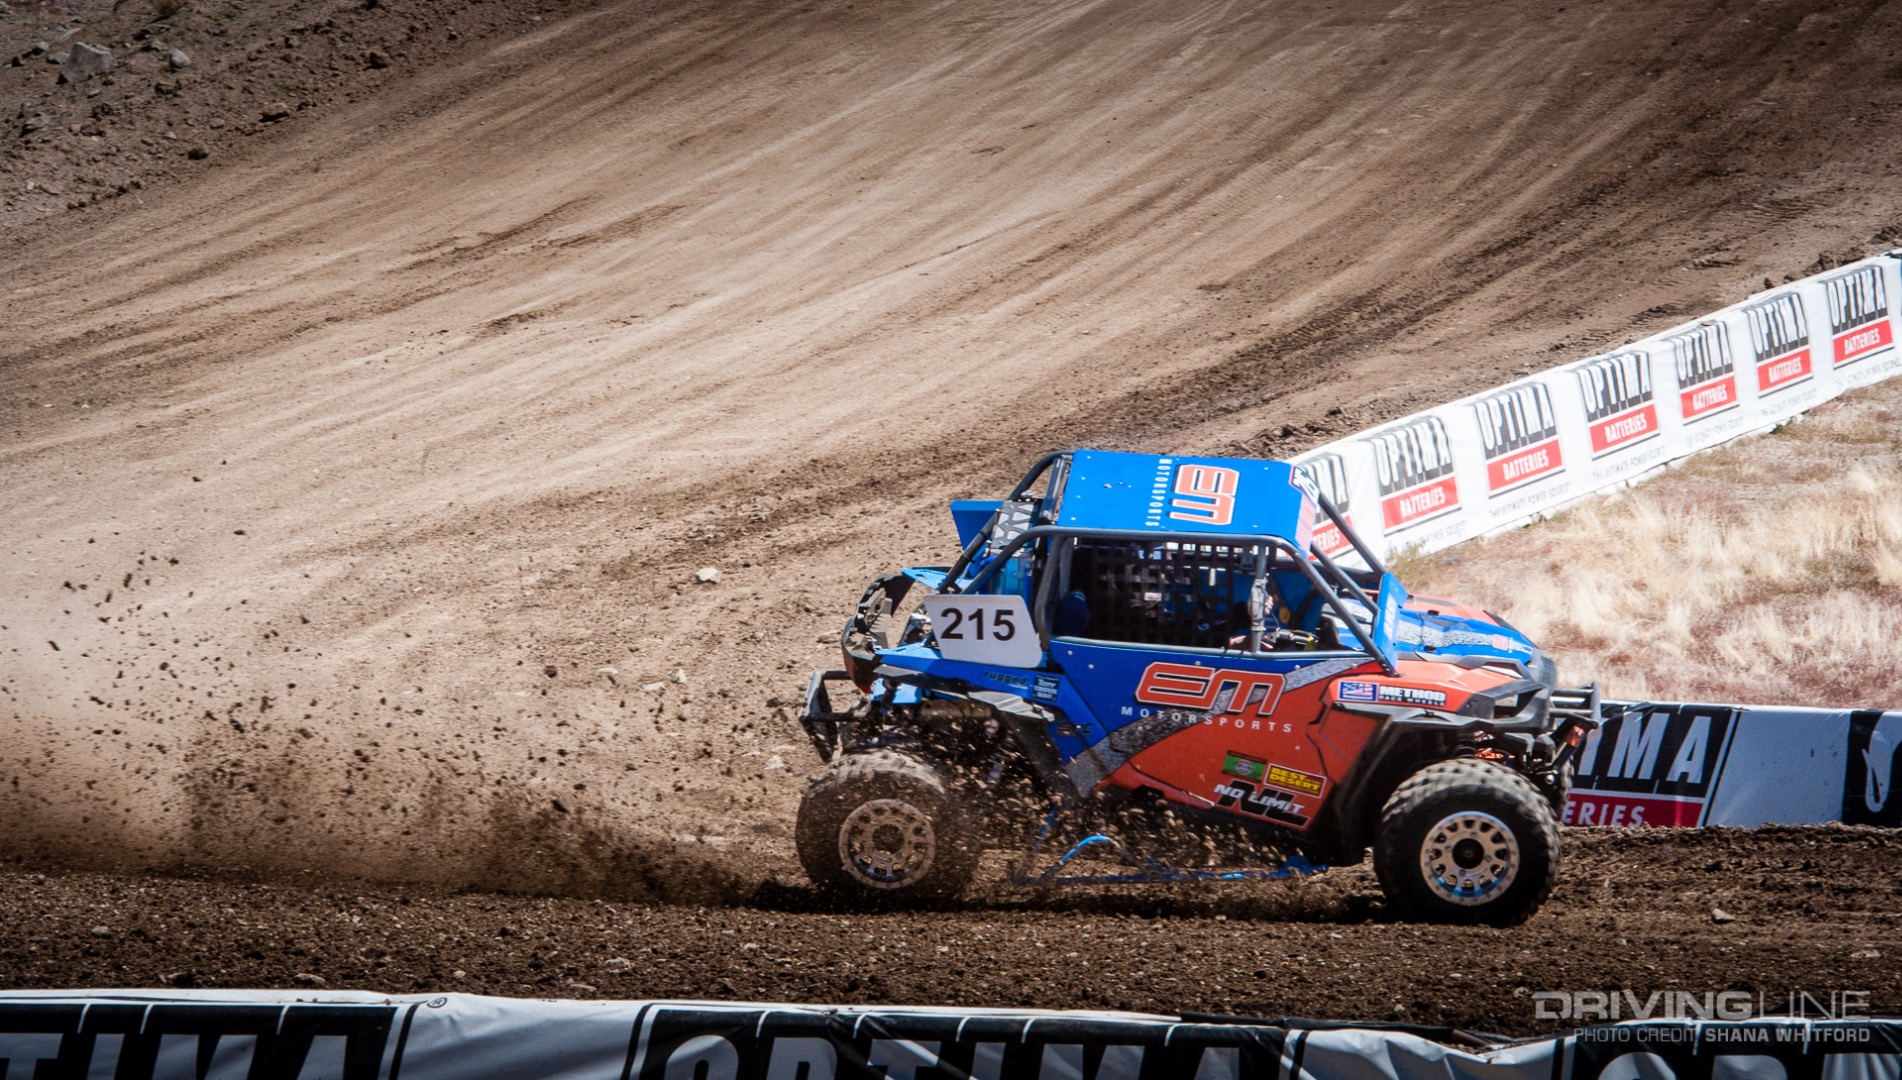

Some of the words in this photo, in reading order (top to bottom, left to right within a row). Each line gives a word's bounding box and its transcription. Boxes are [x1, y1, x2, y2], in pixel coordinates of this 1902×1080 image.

[1826, 266, 1887, 327] OPTIMA
[1748, 293, 1807, 354] OPTIMA
[1675, 322, 1731, 381] OPTIMA
[1844, 327, 1881, 355] BATTERIES
[1576, 352, 1650, 414] OPTIMA
[1768, 357, 1801, 383] BATTERIES
[1692, 384, 1728, 411] BATTERIES
[1474, 383, 1554, 450] OPTIMA
[1604, 413, 1648, 444] BATTERIES
[1373, 417, 1451, 486] OPTIMA
[1502, 449, 1549, 481] BATTERIES
[1144, 459, 1172, 526] MOTORSPORTS
[1399, 486, 1446, 518] BATTERIES
[941, 608, 1015, 641] 215
[1135, 661, 1286, 717] EM
[1378, 694, 1403, 702] RACE
[1407, 698, 1446, 707] WHEELS
[1379, 685, 1447, 702] METHOD
[1121, 706, 1292, 733] MOTORSPORTS
[1578, 711, 1711, 784] IMA
[1269, 773, 1320, 790] DESERT
[1271, 767, 1307, 781] BEST
[1213, 784, 1246, 799] NO
[1248, 792, 1305, 815] LIMIT
[1561, 801, 1645, 828] ERIES
